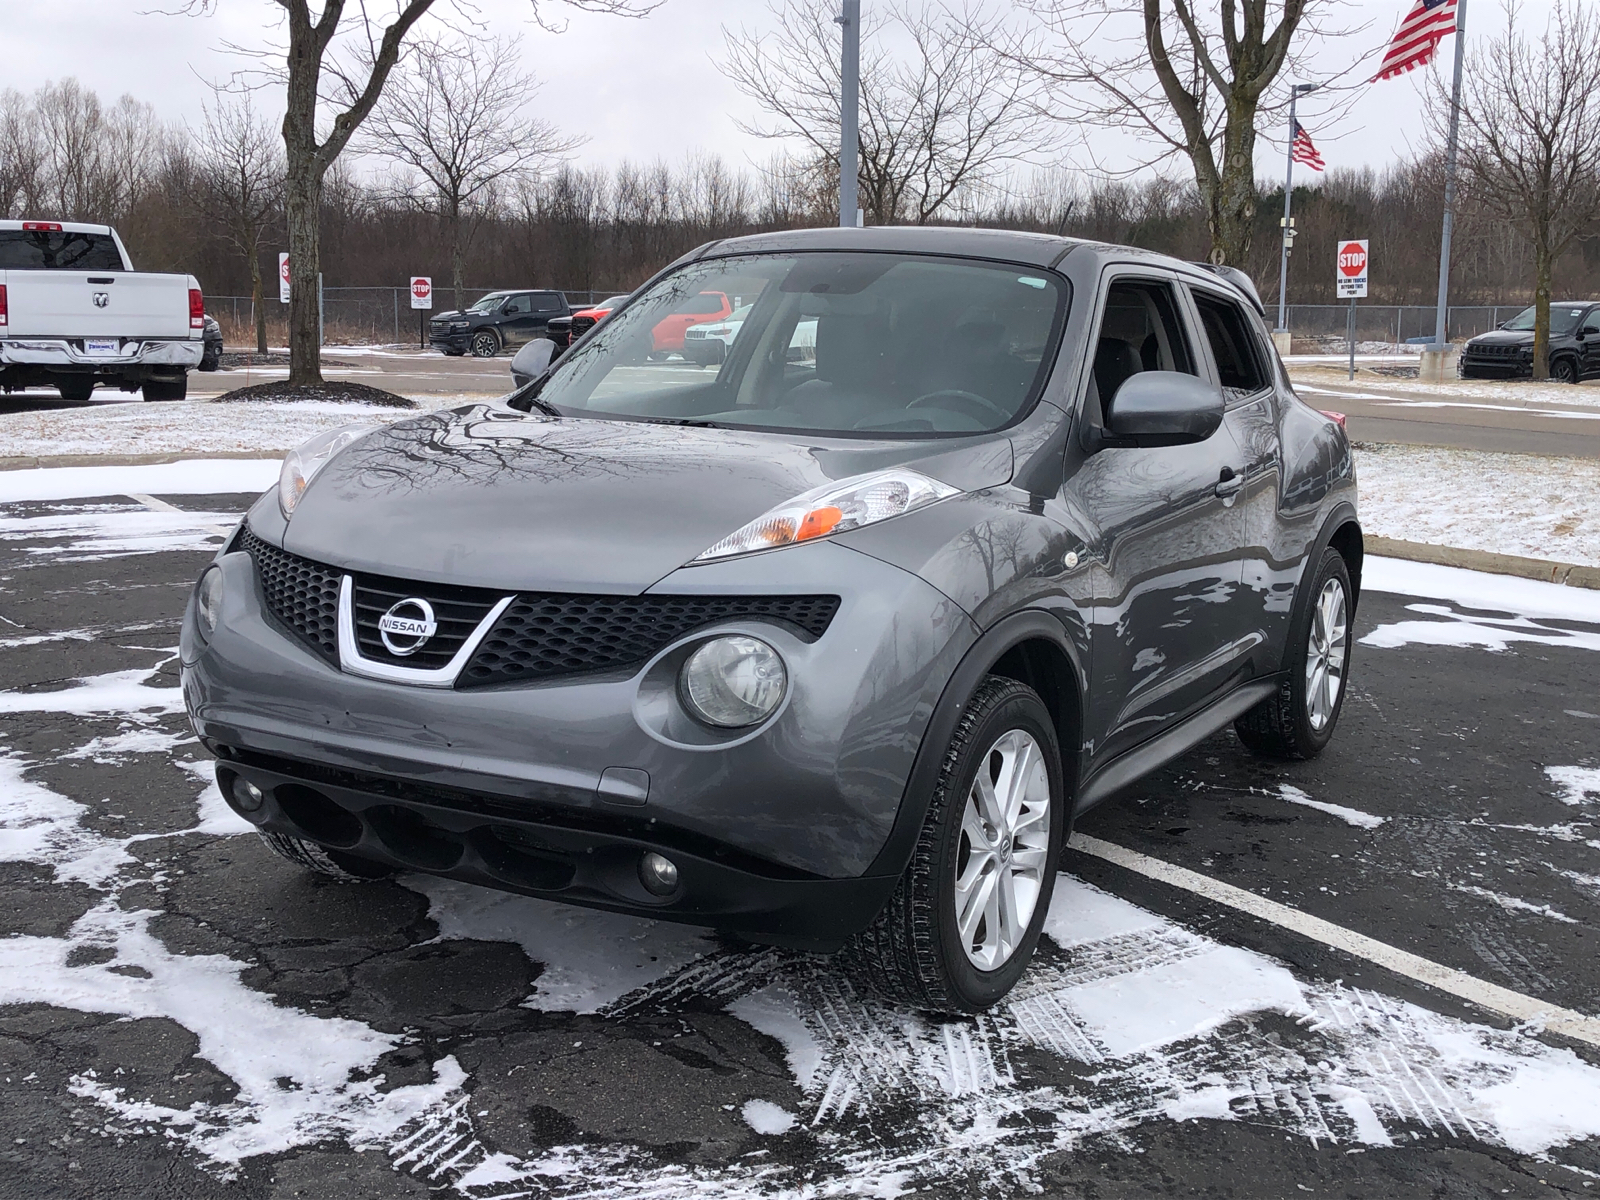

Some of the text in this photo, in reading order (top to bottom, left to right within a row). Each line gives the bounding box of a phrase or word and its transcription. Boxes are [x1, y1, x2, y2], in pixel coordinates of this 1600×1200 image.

[1340, 252, 1365, 267] STOP
[412, 284, 430, 293] STOP
[381, 618, 427, 634] NISSAN
